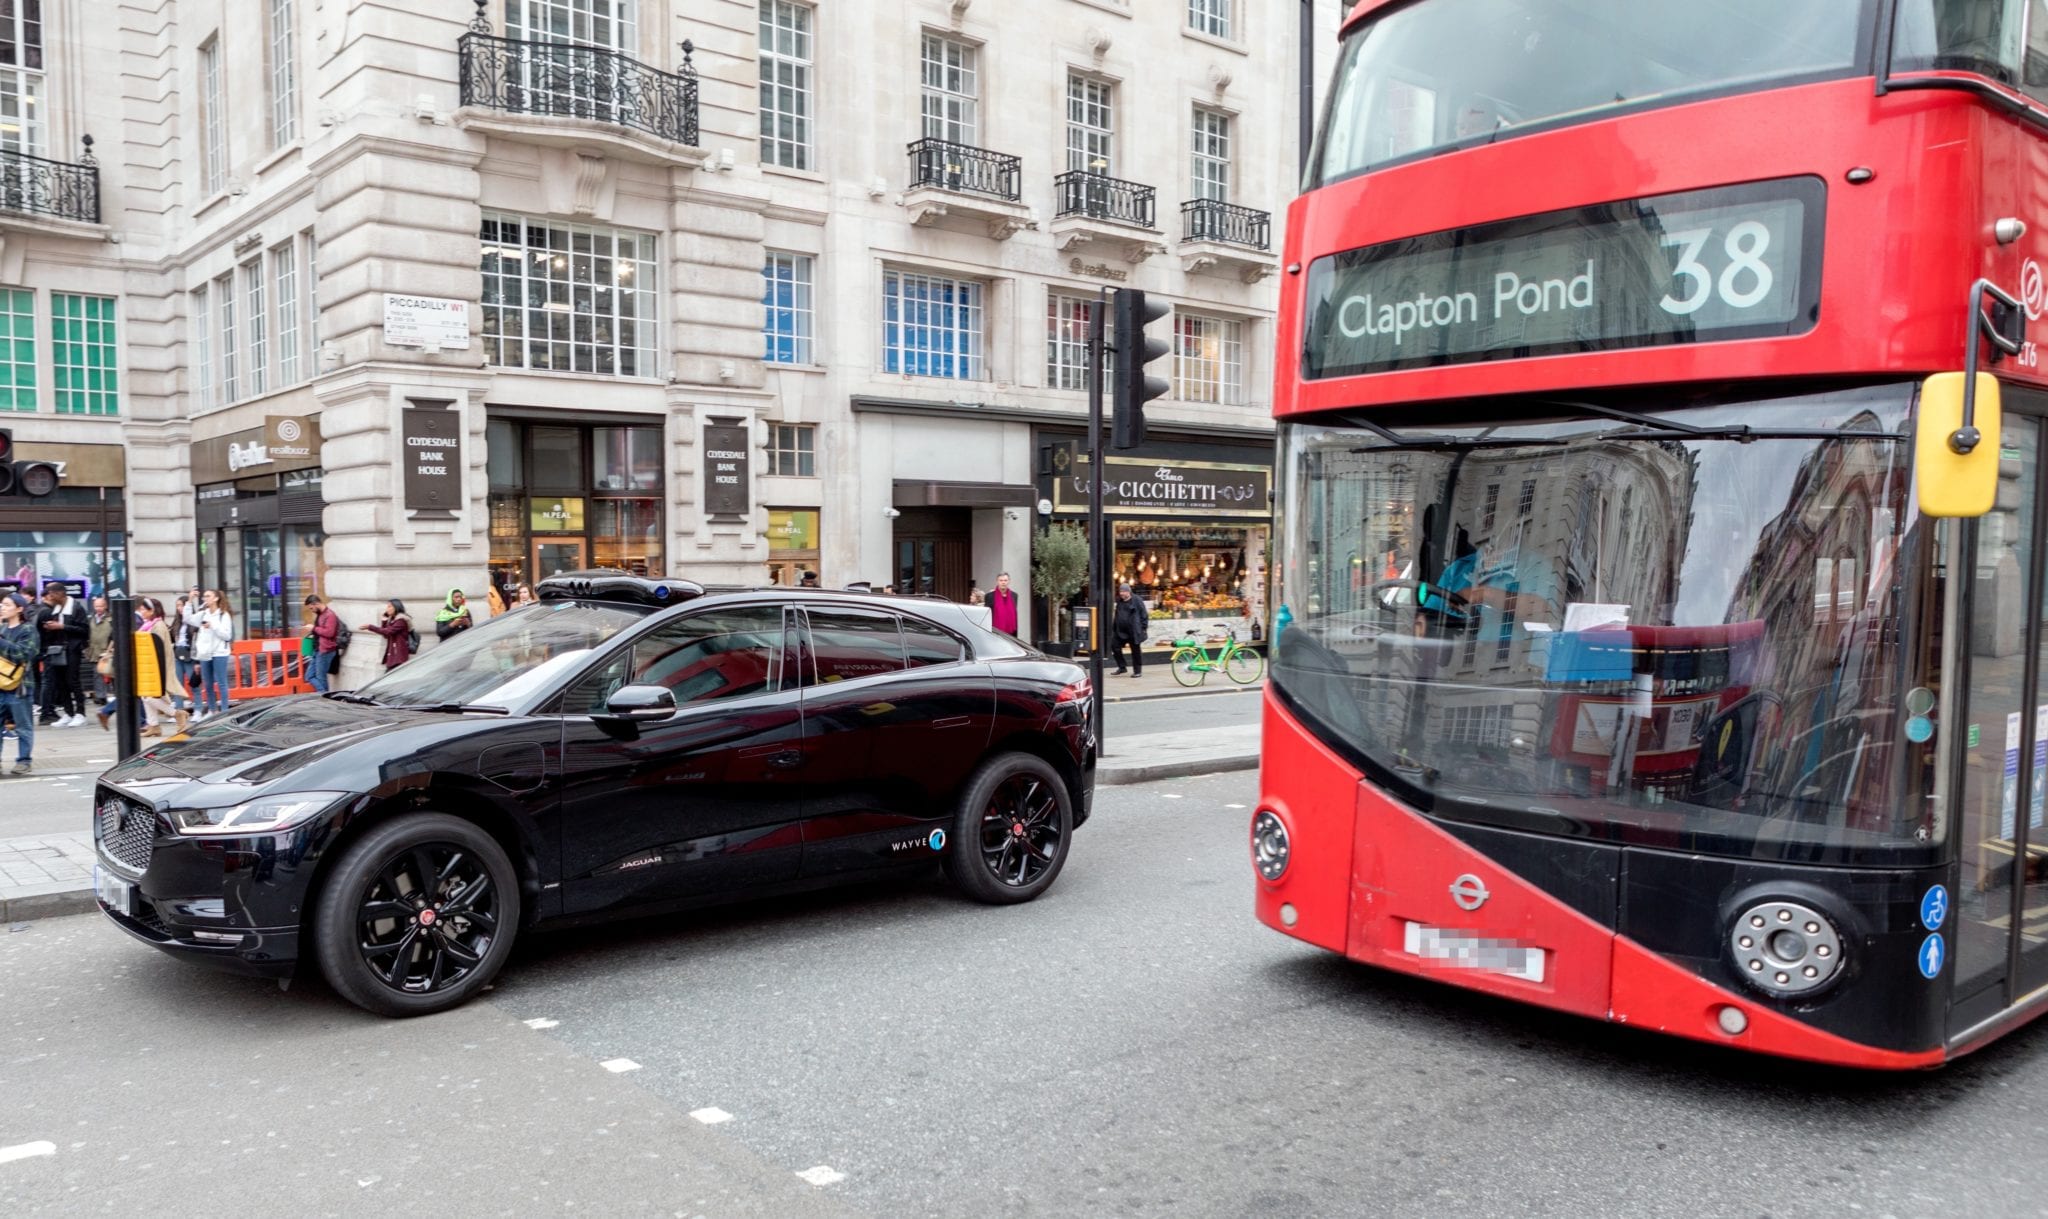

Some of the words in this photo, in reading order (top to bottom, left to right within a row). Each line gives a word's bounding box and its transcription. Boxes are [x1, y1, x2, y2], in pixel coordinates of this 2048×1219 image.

[1338, 290, 1477, 344] Clapton
[1494, 259, 1594, 319] Pond
[1659, 221, 1774, 316] 38
[389, 297, 447, 310] PICCADILLY
[451, 303, 464, 312] W1
[407, 437, 458, 447] CLYDESDALE
[420, 452, 444, 461] BANK
[707, 450, 746, 459] CLYDESDALE
[418, 466, 447, 475] HOUSE
[717, 463, 736, 471] BANK
[715, 476, 739, 484] HOUSE
[1119, 481, 1216, 500] CICCHETTI
[892, 837, 927, 851] WAYVE
[620, 856, 662, 869] JAGUAR
